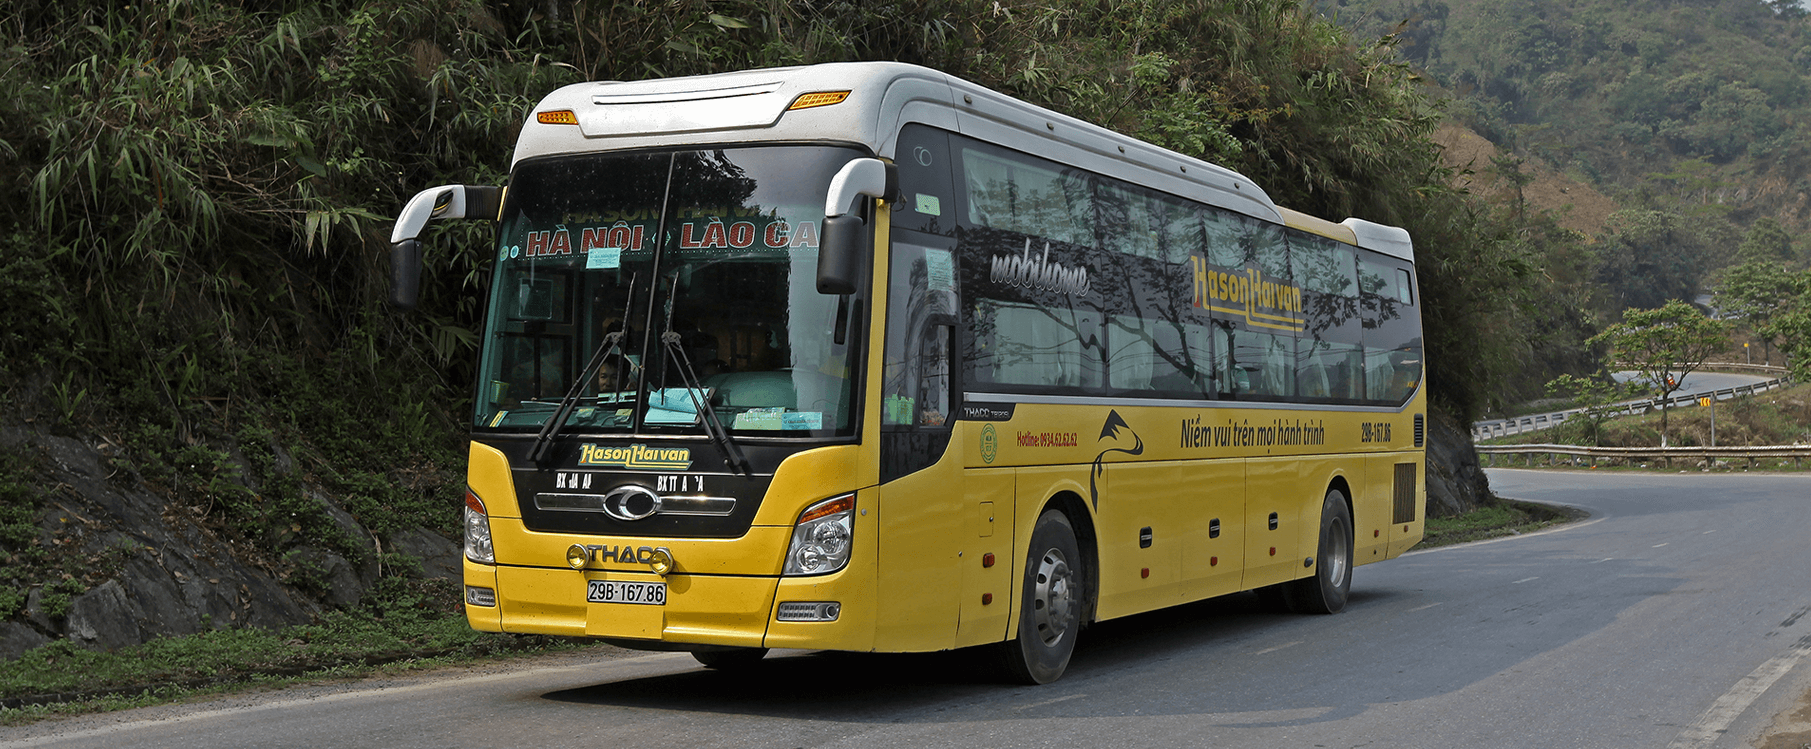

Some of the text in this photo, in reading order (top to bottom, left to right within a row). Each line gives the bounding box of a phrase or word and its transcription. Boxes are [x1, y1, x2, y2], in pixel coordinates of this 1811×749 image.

[526, 224, 572, 257] HÀ
[680, 216, 755, 248] LÀO
[764, 221, 820, 249] CA
[990, 237, 1091, 297] mobihome
[1017, 431, 1078, 447] Hotline: 0934.62.62.62
[1180, 414, 1325, 454] Niềm vui trên mọi hành trình
[556, 472, 567, 489] BX
[657, 475, 668, 491] BX
[586, 544, 670, 564] THAC
[589, 582, 664, 603] 29B-167.86
